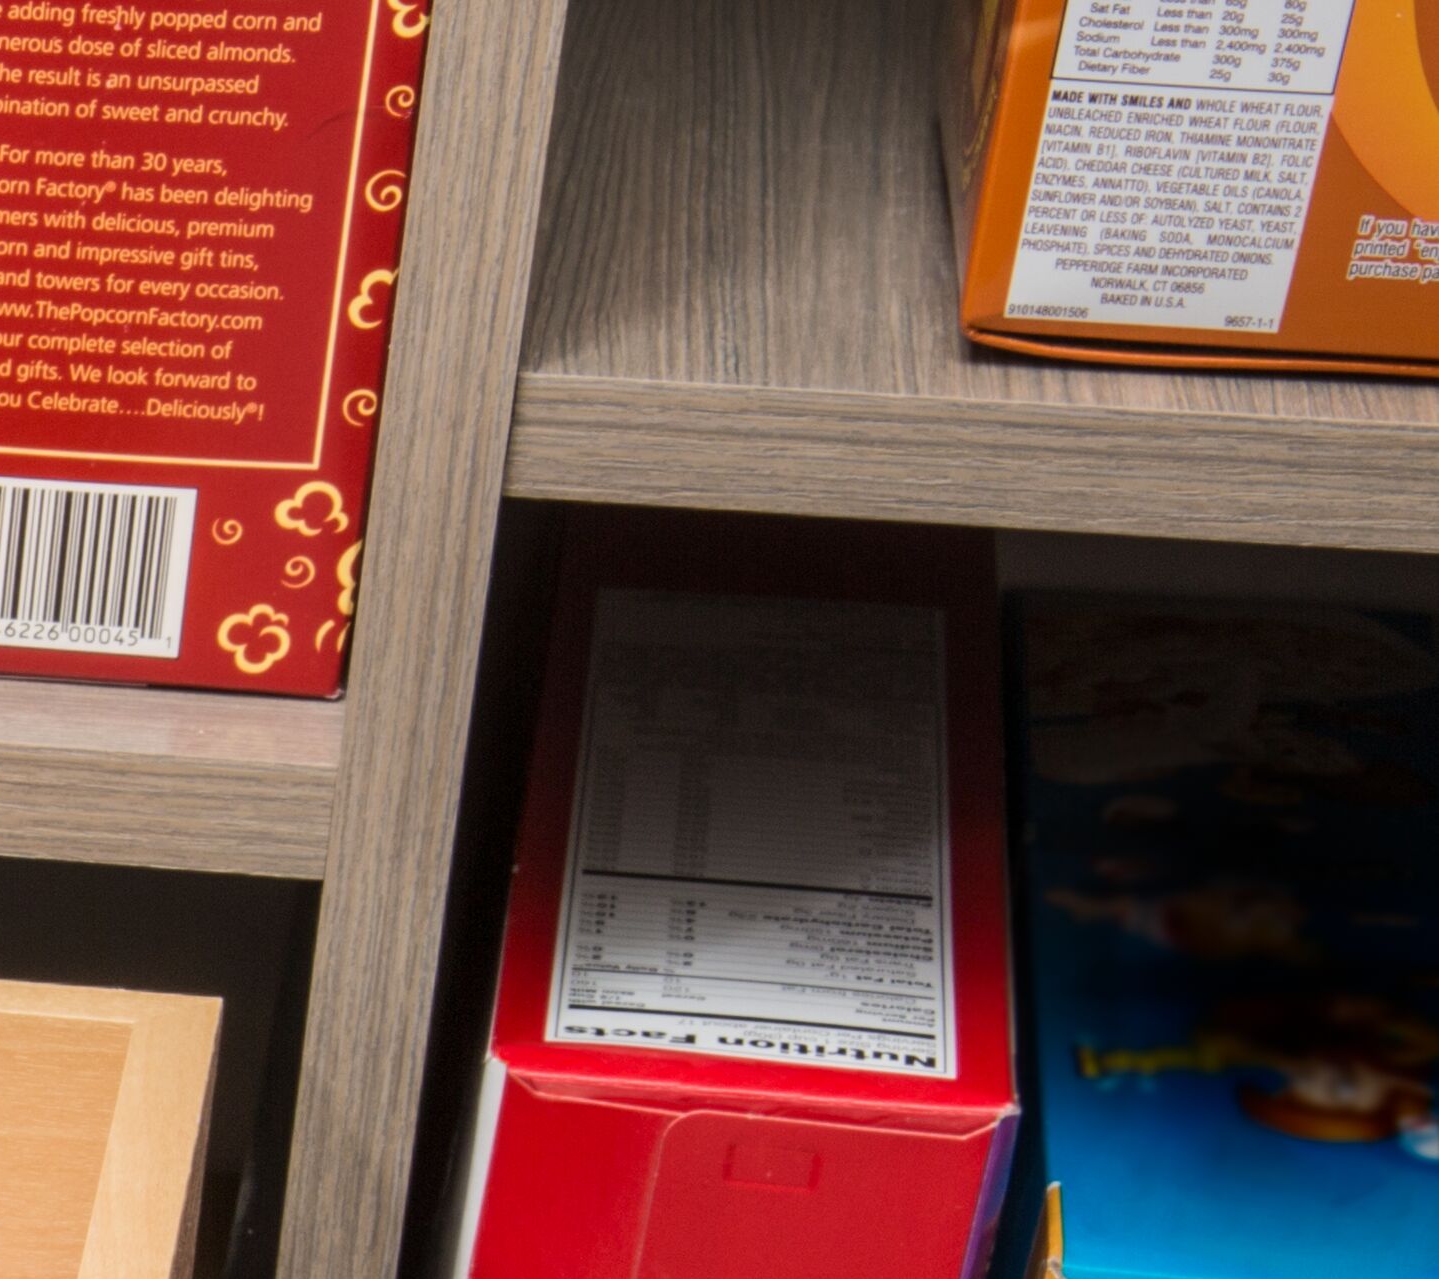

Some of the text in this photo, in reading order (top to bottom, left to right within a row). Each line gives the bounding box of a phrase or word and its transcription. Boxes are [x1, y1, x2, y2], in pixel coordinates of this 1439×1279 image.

[28, 66, 81, 86] result
[86, 67, 101, 87] is
[104, 73, 131, 89] an
[137, 74, 259, 95] unsurpassed
[1049, 89, 1083, 102] MADE
[1088, 92, 1117, 104] WITH
[1121, 94, 1163, 108] SMILES
[1167, 97, 1191, 109] AND
[1196, 99, 1234, 112] WHOLE
[1241, 102, 1279, 113] WHEAT
[74, 98, 97, 118] of
[101, 104, 159, 121] sweet
[164, 104, 203, 123] and
[207, 106, 287, 131] crunchy.
[121, 181, 154, 202] has
[159, 183, 208, 204] been
[213, 186, 313, 212] delighting
[43, 209, 86, 228] with
[91, 211, 179, 236] delicious,
[186, 218, 274, 239] premium
[1353, 241, 1407, 257] printed
[1349, 261, 1418, 279] purchase
[1224, 316, 1275, 330] 9657-1-1
[68, 625, 141, 647] 00045
[565, 1025, 935, 1068] Nutrition Facts
